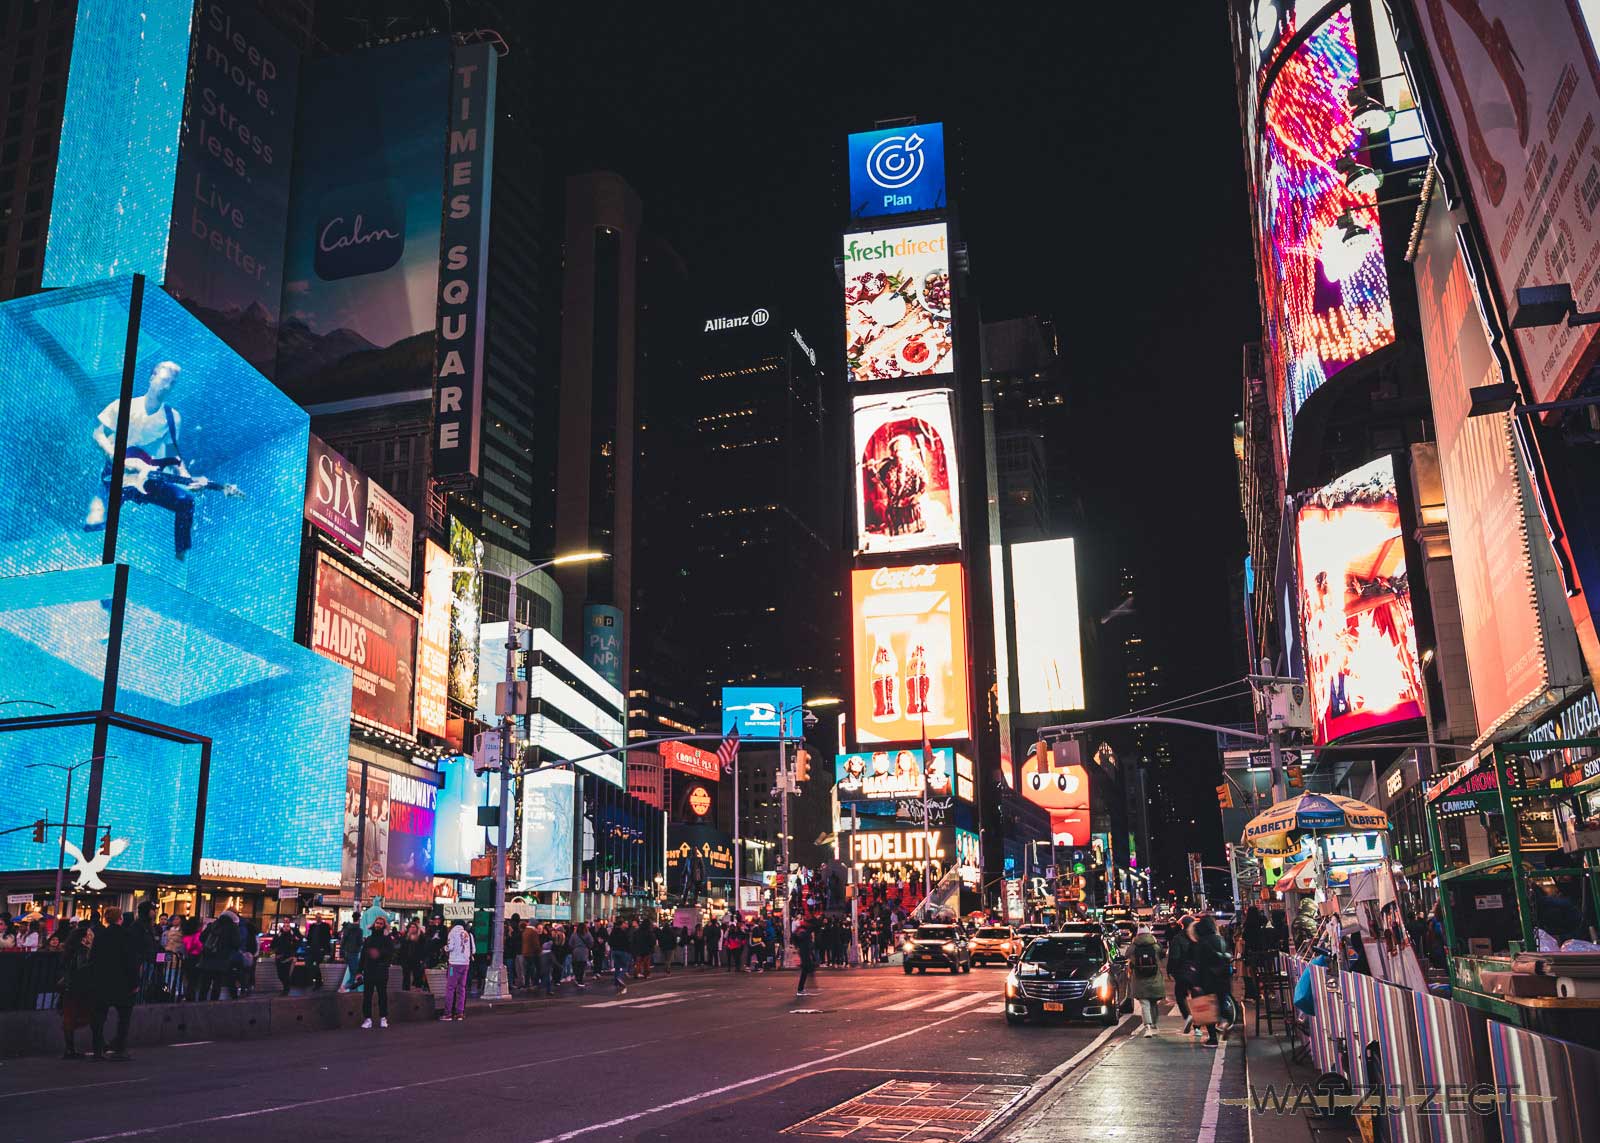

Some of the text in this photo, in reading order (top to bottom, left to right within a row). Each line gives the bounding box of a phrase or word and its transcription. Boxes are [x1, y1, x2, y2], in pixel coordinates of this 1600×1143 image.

[209, 6, 277, 80] Sleep
[205, 43, 275, 116] more.
[202, 88, 273, 164] Stress
[199, 120, 252, 184] less.
[195, 173, 244, 229] Live
[883, 194, 913, 208] Plan
[191, 207, 271, 288] better.
[319, 214, 400, 252] Calm
[845, 235, 946, 262] freshdirect
[439, 64, 478, 450] TIMES SQUARE
[704, 315, 750, 332] Allianz
[1584, 758, 1600, 778] SON
[1442, 799, 1479, 812] CAMERA
[1248, 818, 1294, 837] SABRETT
[849, 830, 946, 862] FIDELITY.
[385, 877, 434, 902] CHICAGO
